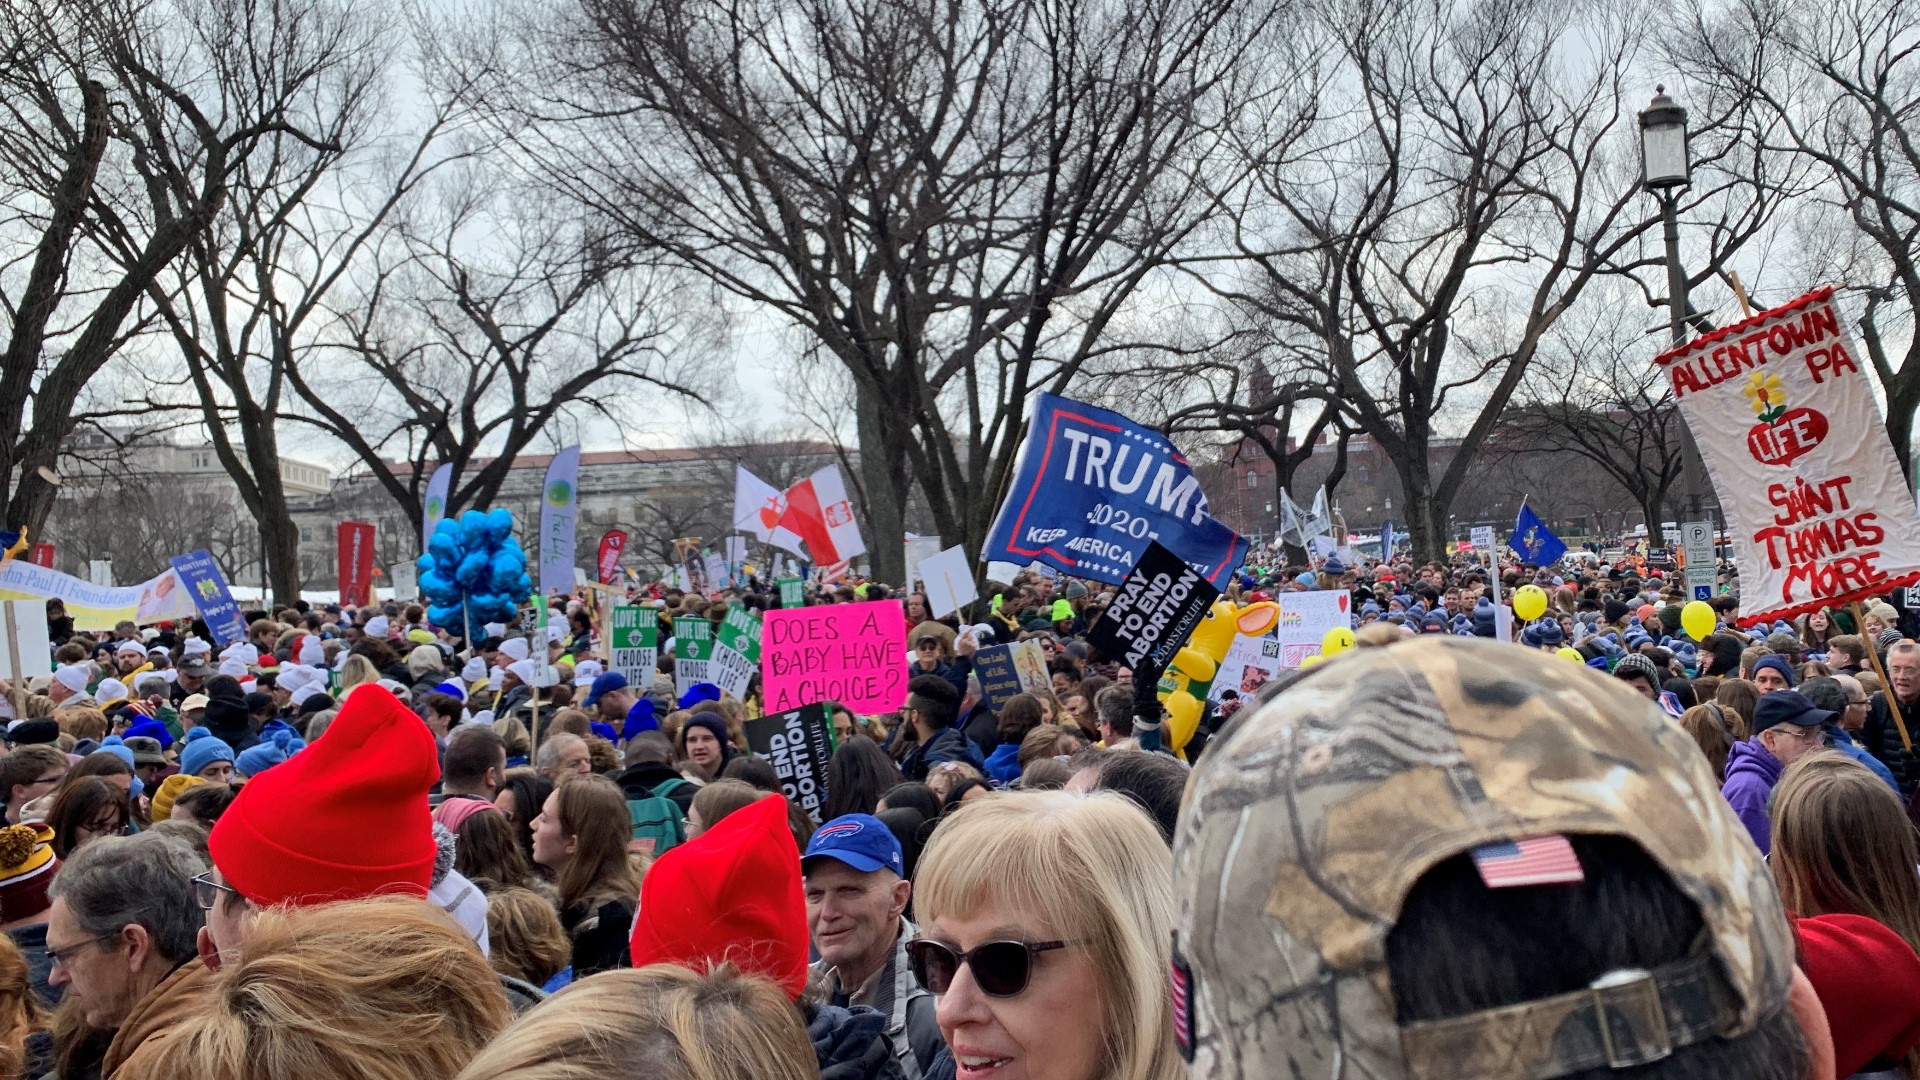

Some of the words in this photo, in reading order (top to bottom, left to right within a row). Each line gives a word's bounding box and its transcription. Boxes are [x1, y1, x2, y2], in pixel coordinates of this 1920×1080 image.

[1672, 304, 1840, 398] ALLENTOWN
[1805, 342, 1858, 384] PA
[1751, 412, 1818, 462] LIFE
[1026, 526, 1068, 543] KEEP
[1064, 536, 1133, 568] AMERICA
[1753, 512, 1885, 570] THOMAS
[25, 569, 55, 593] Paul
[68, 584, 137, 605] Foundation
[1106, 567, 1149, 624] PRAY
[1783, 551, 1889, 604] MORE
[615, 609, 637, 628] LOVE
[639, 609, 657, 628] LIFE
[727, 606, 749, 634] LOVE
[1115, 613, 1143, 641] TO
[1135, 572, 1172, 615] END
[1124, 568, 1200, 670] ABORTION
[675, 621, 694, 639] LOVE
[695, 621, 710, 640] LIFE
[770, 616, 839, 645] DOES
[859, 610, 884, 636] A
[616, 649, 652, 667] CHOOSE
[680, 660, 708, 679] CHOOSE
[716, 645, 751, 680] CHOOSE
[771, 644, 832, 677] BABY
[842, 639, 901, 670] HAVE
[625, 668, 643, 686] LIFE
[717, 668, 738, 692] LIFE
[776, 687, 792, 712] A
[798, 668, 900, 707] CHOICE?
[770, 733, 794, 779] END
[783, 711, 823, 823] ABORTION
